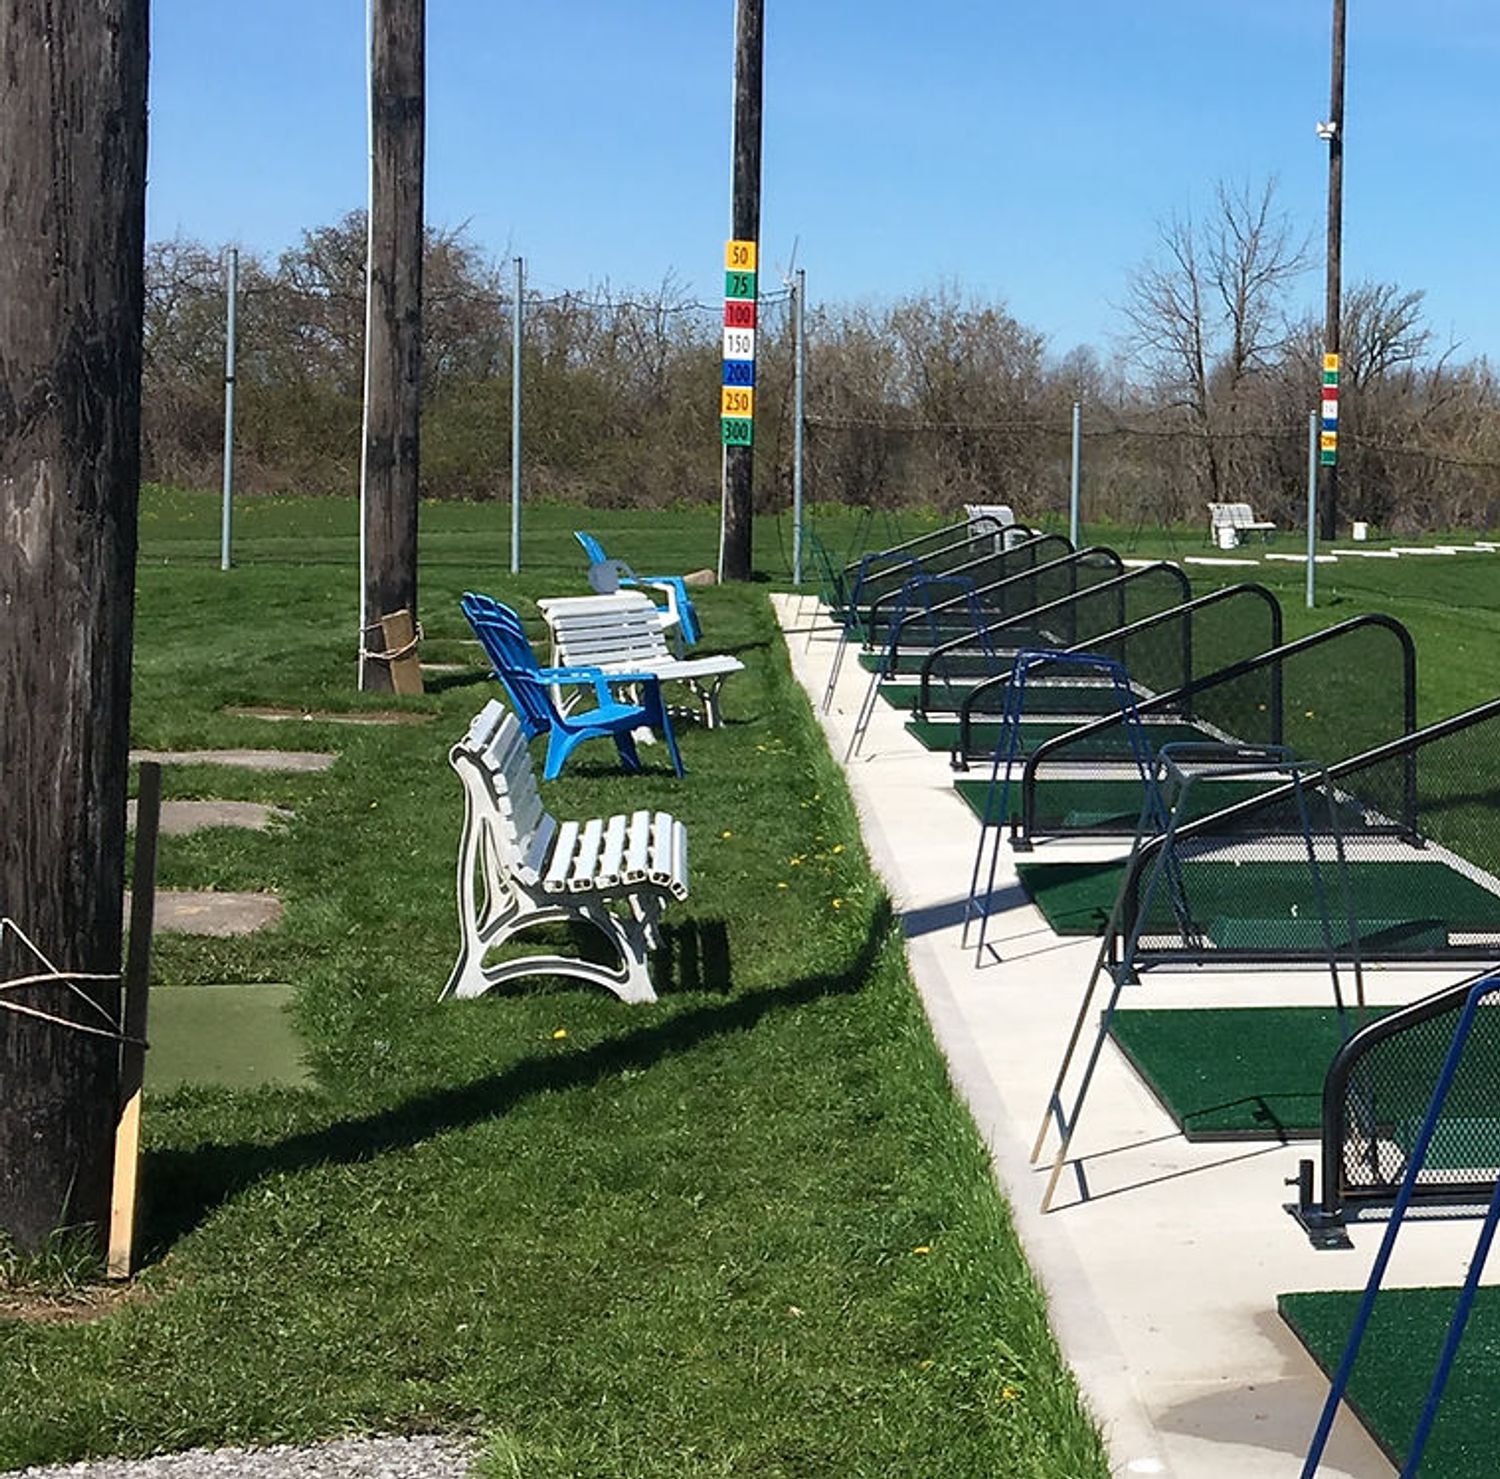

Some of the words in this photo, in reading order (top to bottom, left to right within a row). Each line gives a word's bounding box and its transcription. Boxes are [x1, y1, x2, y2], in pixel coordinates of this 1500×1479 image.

[732, 247, 749, 264] 50
[732, 276, 748, 294] 75
[728, 306, 751, 323] 100
[728, 335, 750, 353] 150
[727, 365, 750, 382] 200
[726, 393, 749, 410] 250
[725, 422, 748, 440] 300
